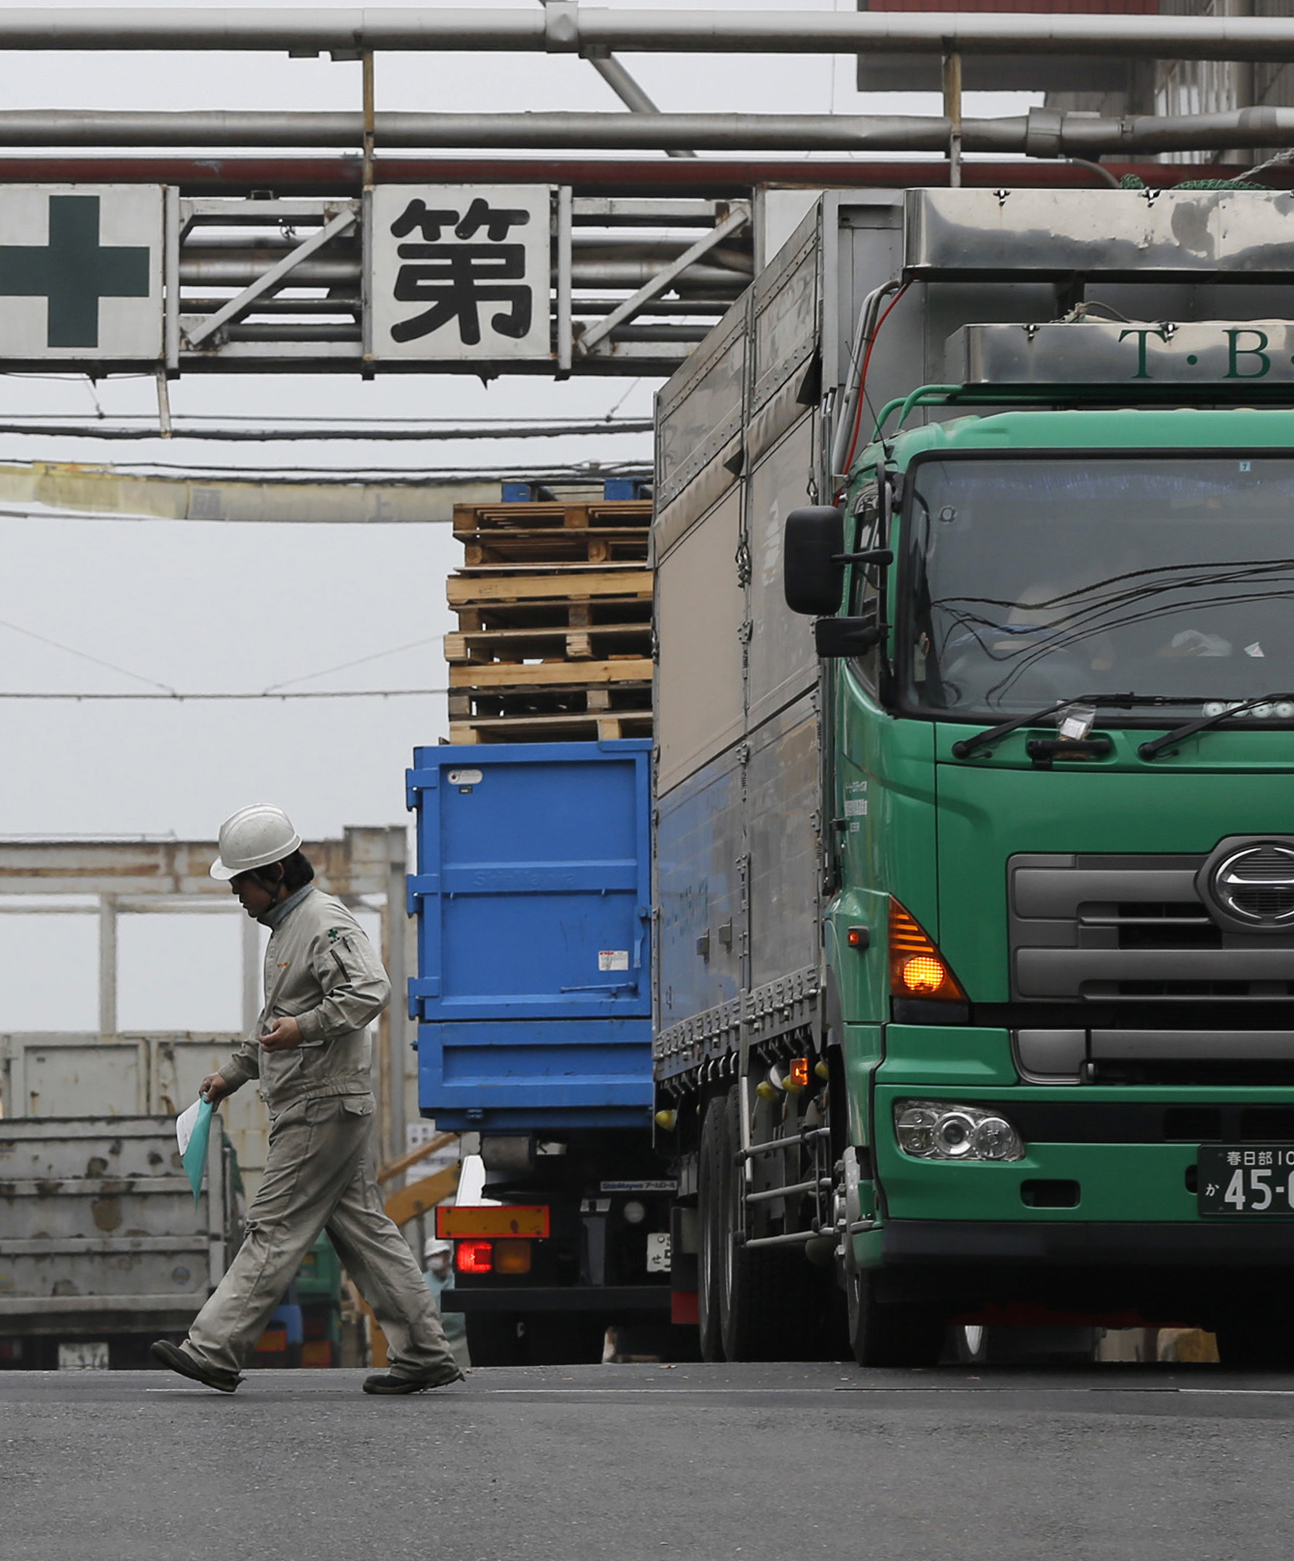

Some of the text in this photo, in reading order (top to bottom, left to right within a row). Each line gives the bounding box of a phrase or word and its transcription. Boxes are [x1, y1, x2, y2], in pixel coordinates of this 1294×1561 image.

[390, 198, 532, 345] 第
[1227, 1151, 1273, 1166] 春日部
[1205, 1169, 1294, 1210] か 45-
